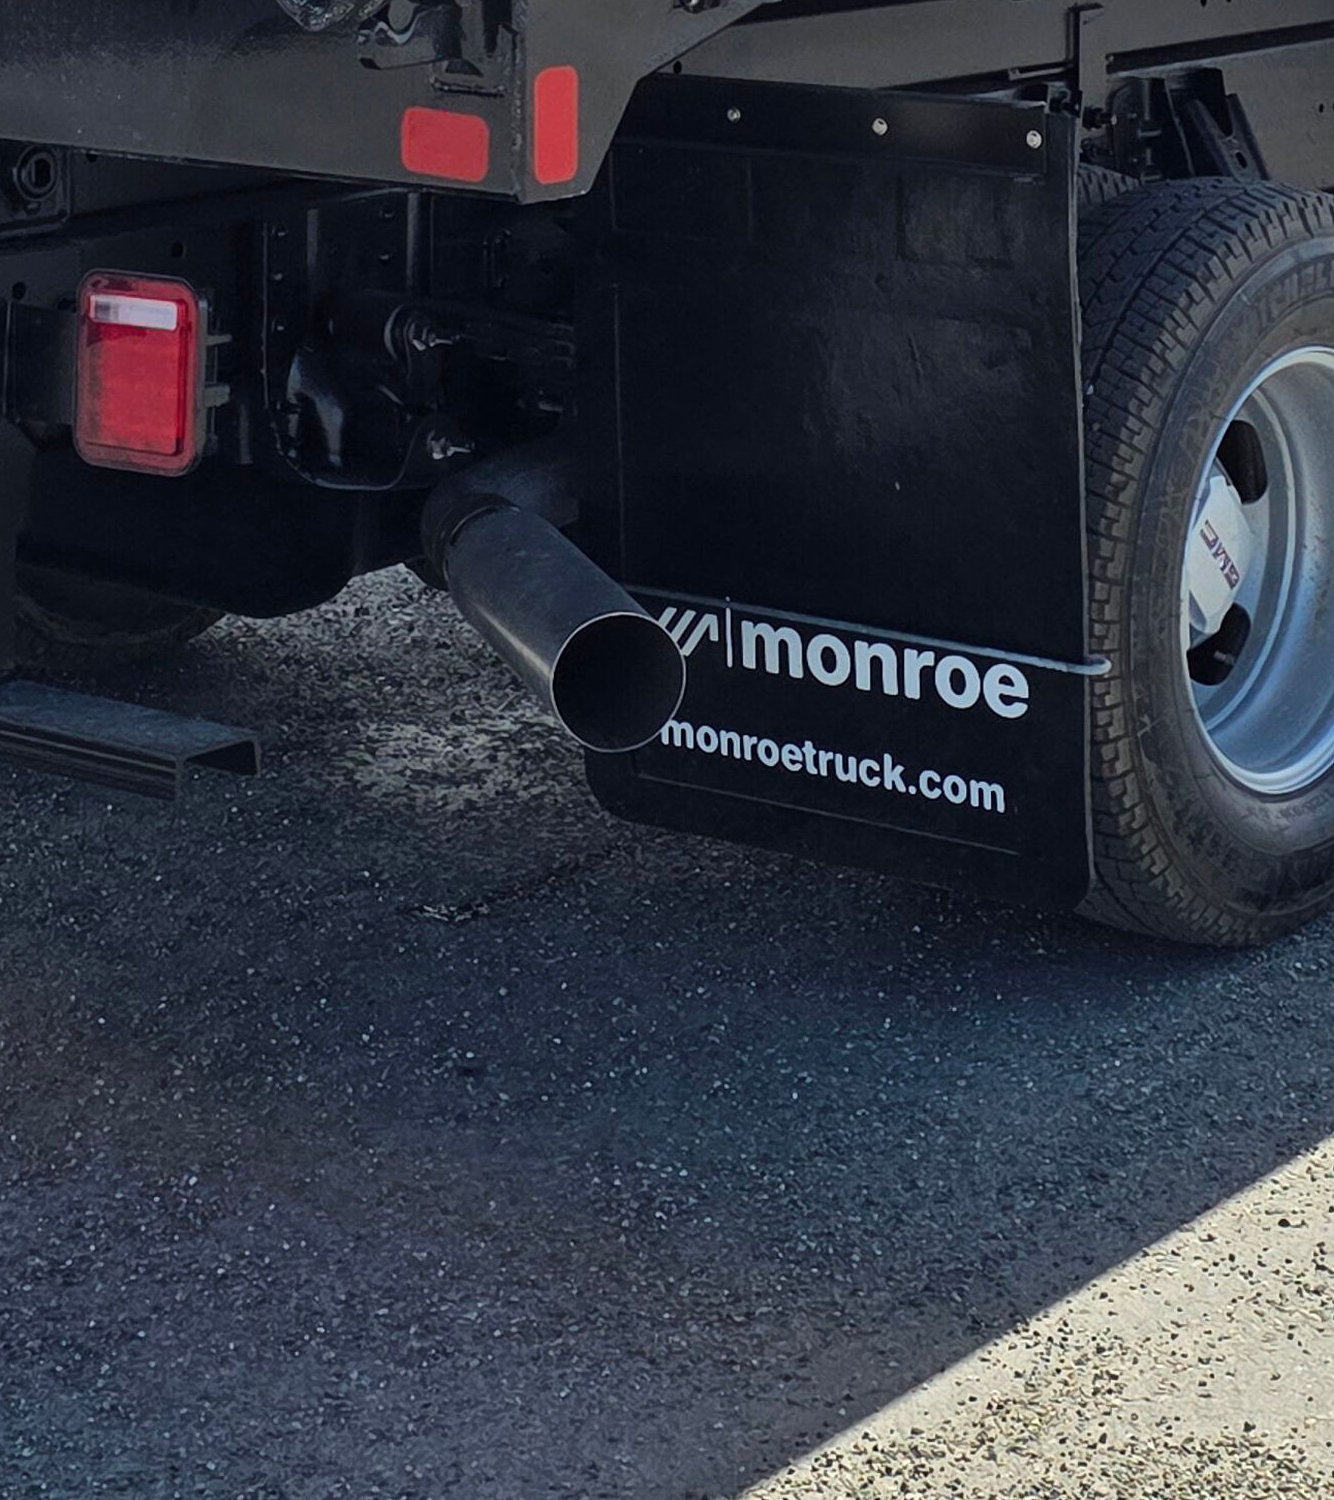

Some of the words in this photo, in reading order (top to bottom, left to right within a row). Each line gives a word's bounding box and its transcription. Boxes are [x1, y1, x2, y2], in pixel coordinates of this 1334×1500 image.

[1199, 519, 1240, 590] GMC
[741, 619, 1030, 719] monroe
[661, 718, 1006, 813] monroetruck.com
